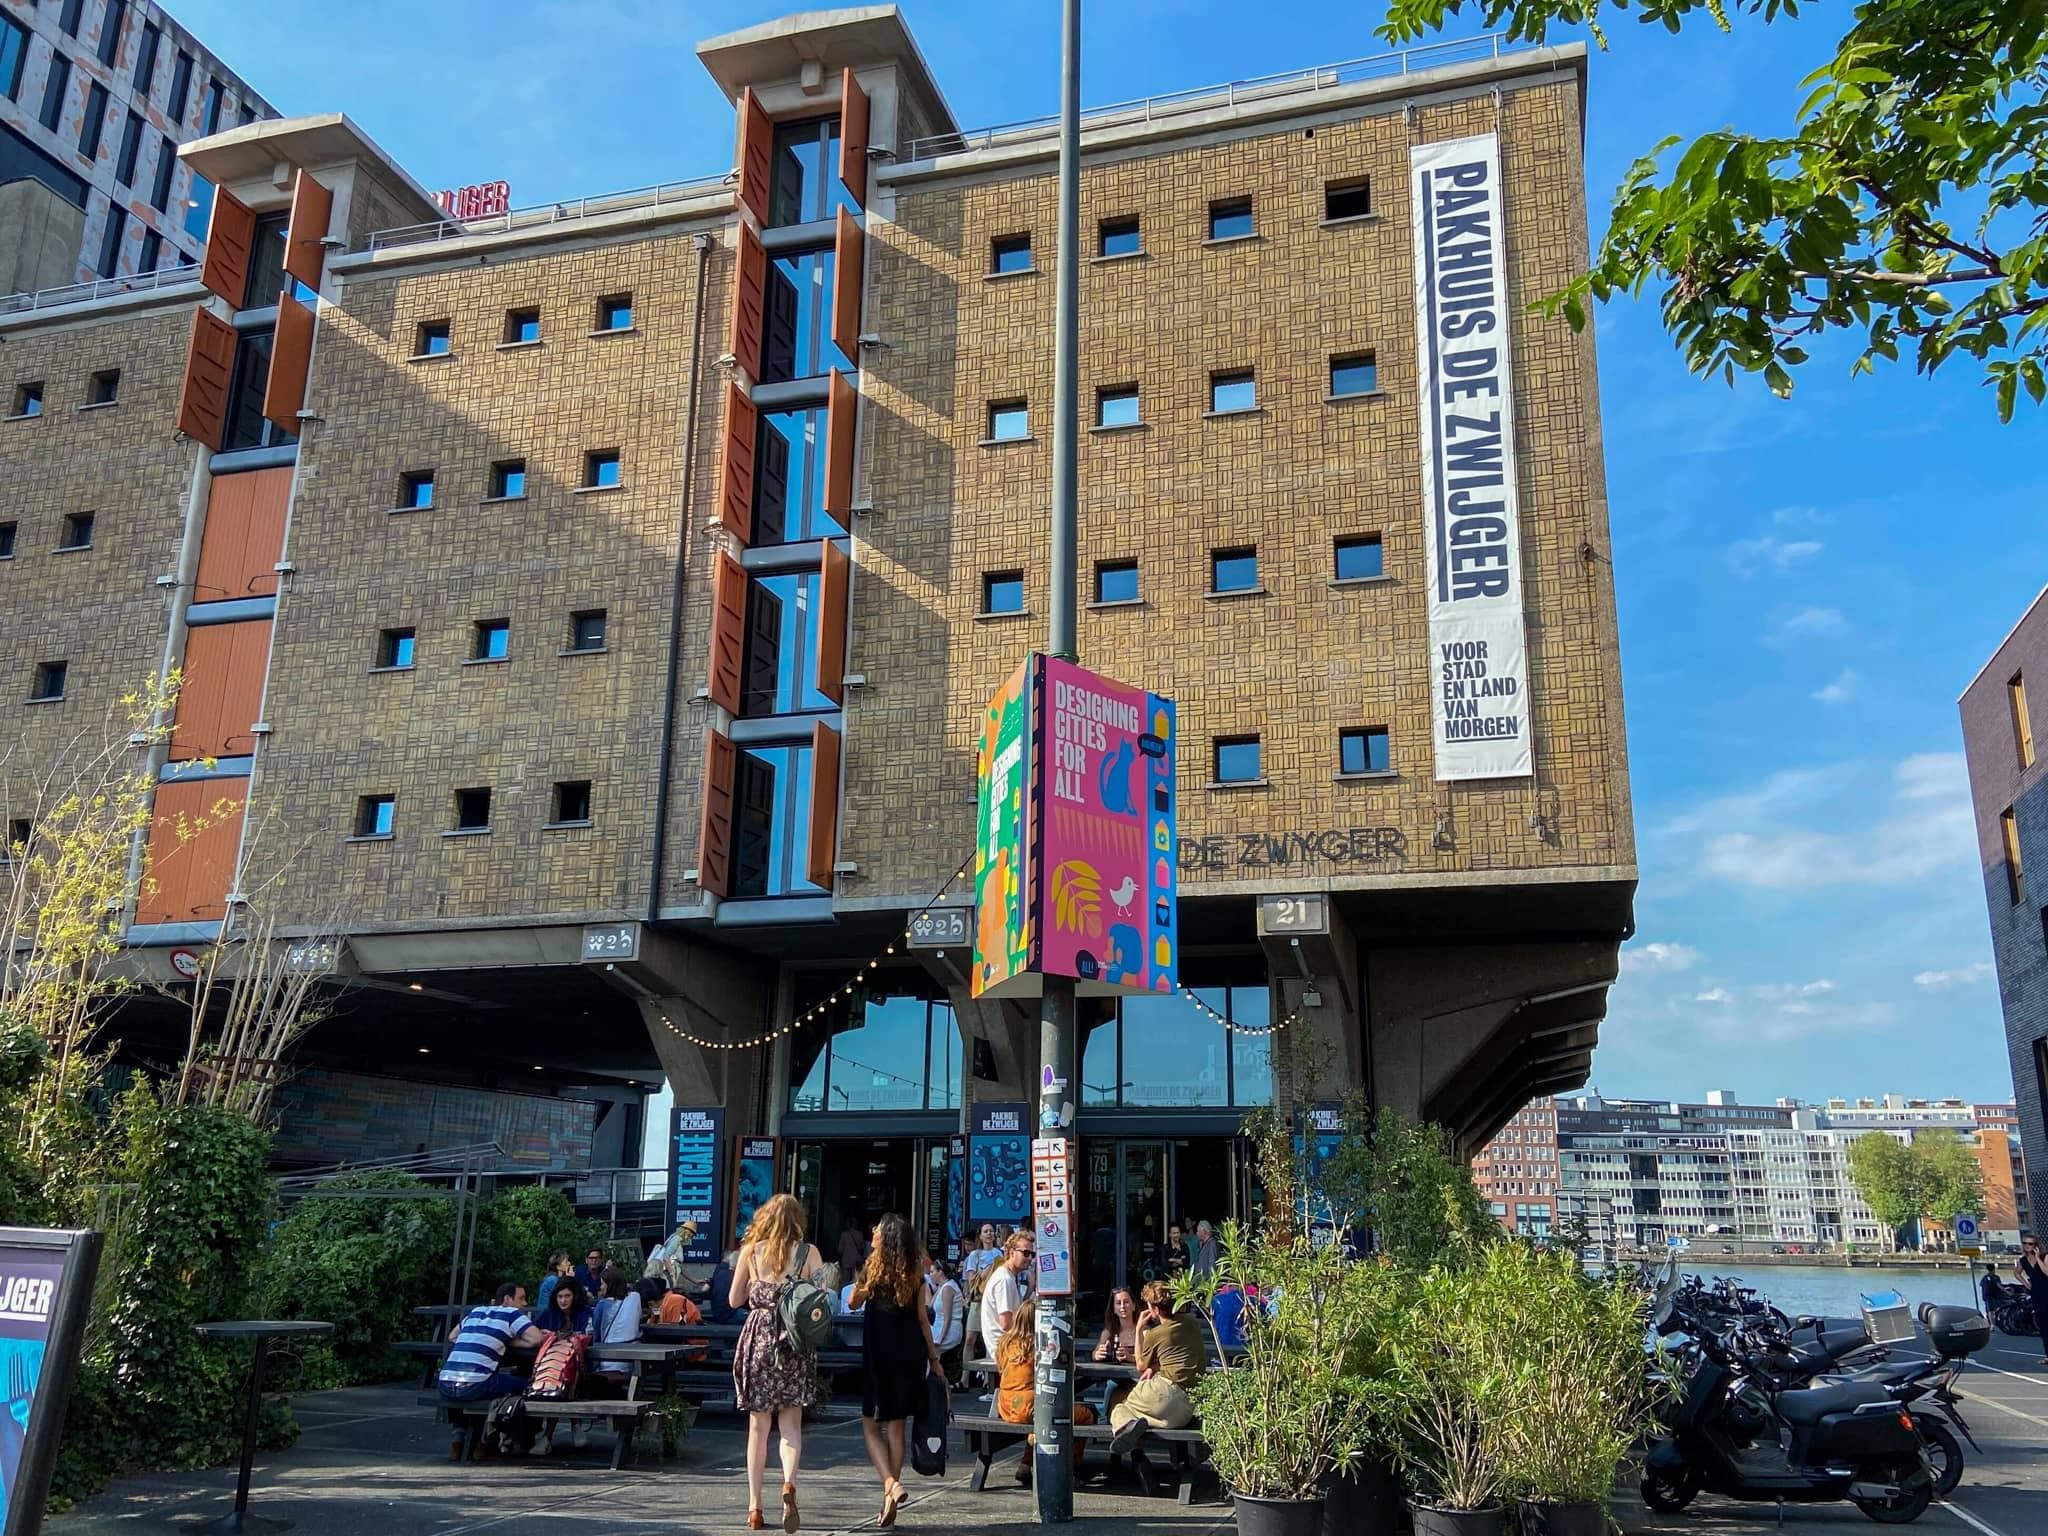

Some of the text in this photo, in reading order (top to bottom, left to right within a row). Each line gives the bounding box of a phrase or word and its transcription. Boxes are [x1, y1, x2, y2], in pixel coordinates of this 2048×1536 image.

[1434, 160, 1511, 602] PAKHUIS DE ZWIJGER
[1441, 640, 1488, 661] VOOR
[1442, 661, 1487, 680] STAD
[1443, 677, 1518, 699] EN LAND
[1054, 679, 1139, 735] DESIGNING
[1444, 699, 1479, 719] VAN
[1054, 709, 1107, 752] CITIES
[1445, 715, 1519, 739] MORGEN
[1054, 738, 1086, 774] FOR
[1054, 769, 1085, 804] ALL
[1276, 897, 1307, 926] 21
[0, 1276, 54, 1314] JGER
